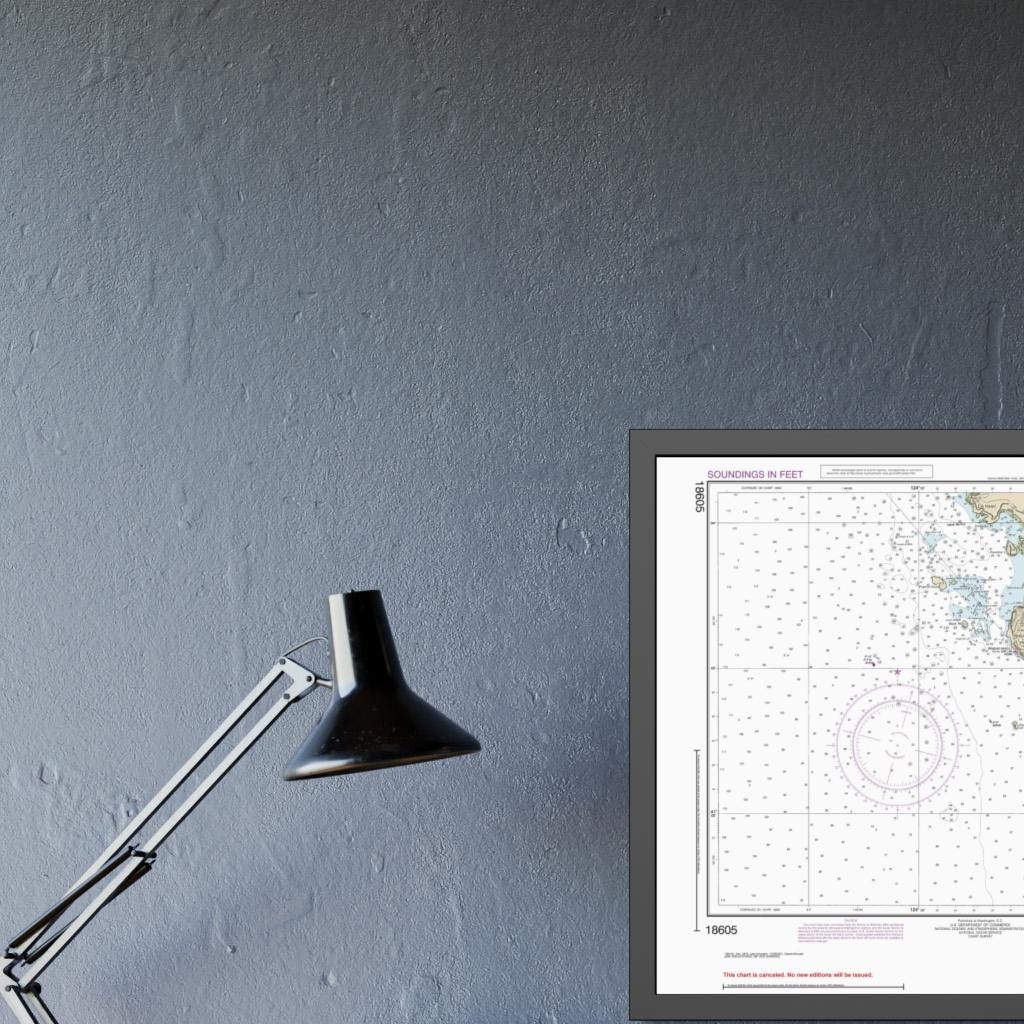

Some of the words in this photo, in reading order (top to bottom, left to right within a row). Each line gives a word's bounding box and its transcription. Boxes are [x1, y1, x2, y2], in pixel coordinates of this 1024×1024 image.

[707, 470, 765, 479] SOUNDINGS
[767, 470, 777, 479] IN
[779, 470, 804, 479] FEET
[695, 481, 705, 513] 18605
[705, 925, 738, 935] 18605
